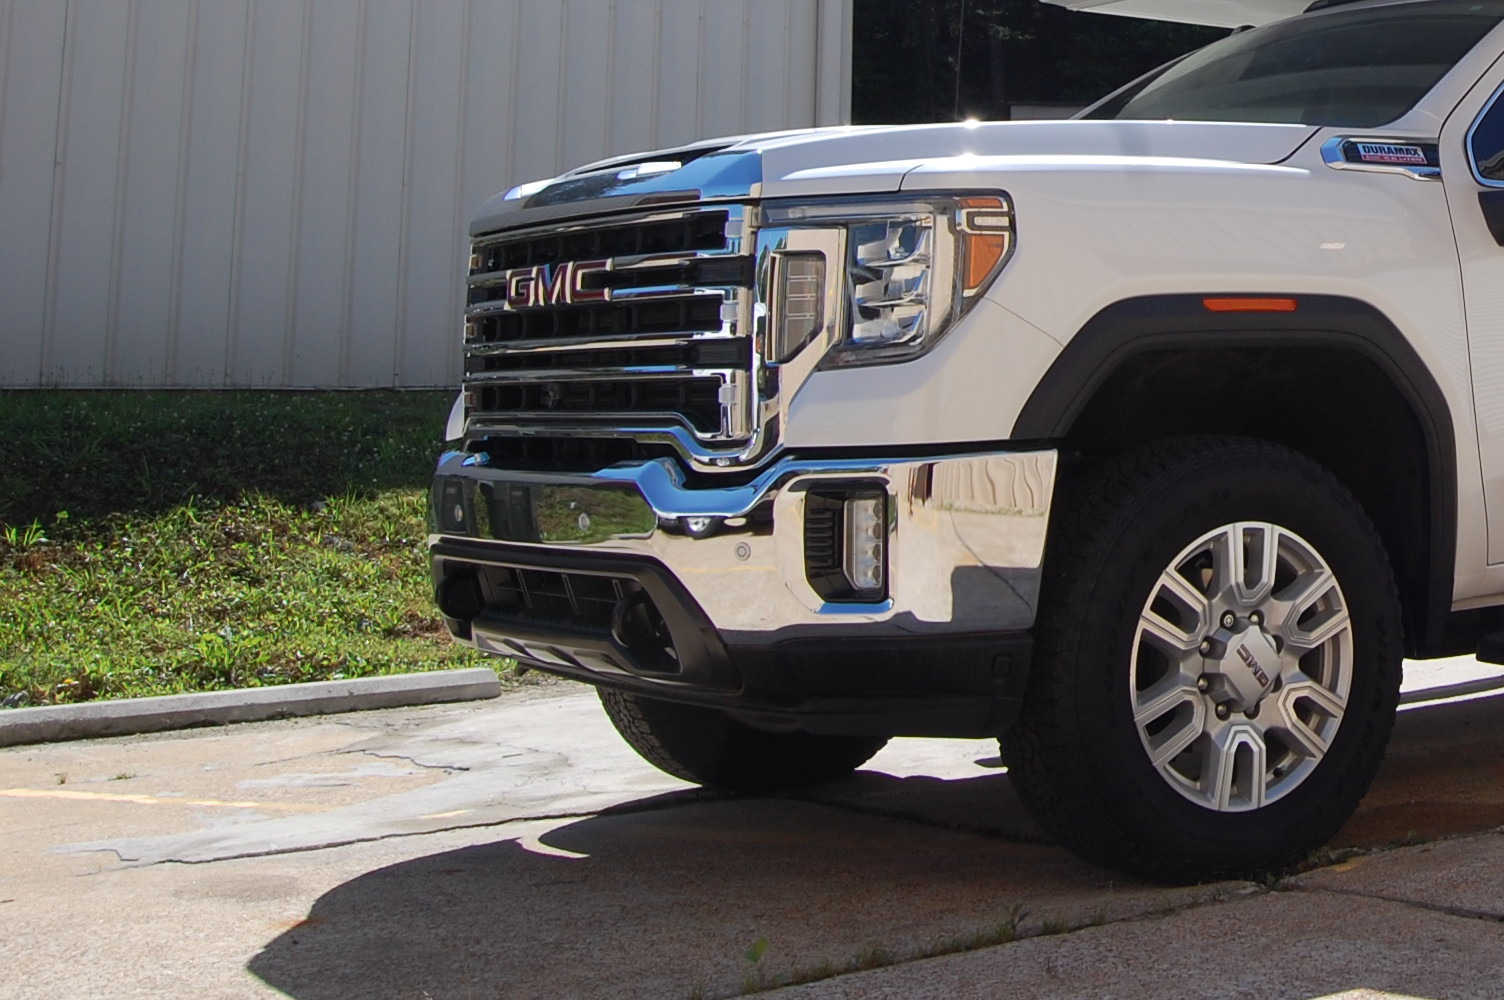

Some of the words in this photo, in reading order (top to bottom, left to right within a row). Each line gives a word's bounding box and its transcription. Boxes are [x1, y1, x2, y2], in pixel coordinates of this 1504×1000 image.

[1362, 145, 1421, 157] DURAMAX
[503, 257, 613, 311] GMC
[1236, 643, 1270, 688] GMC
